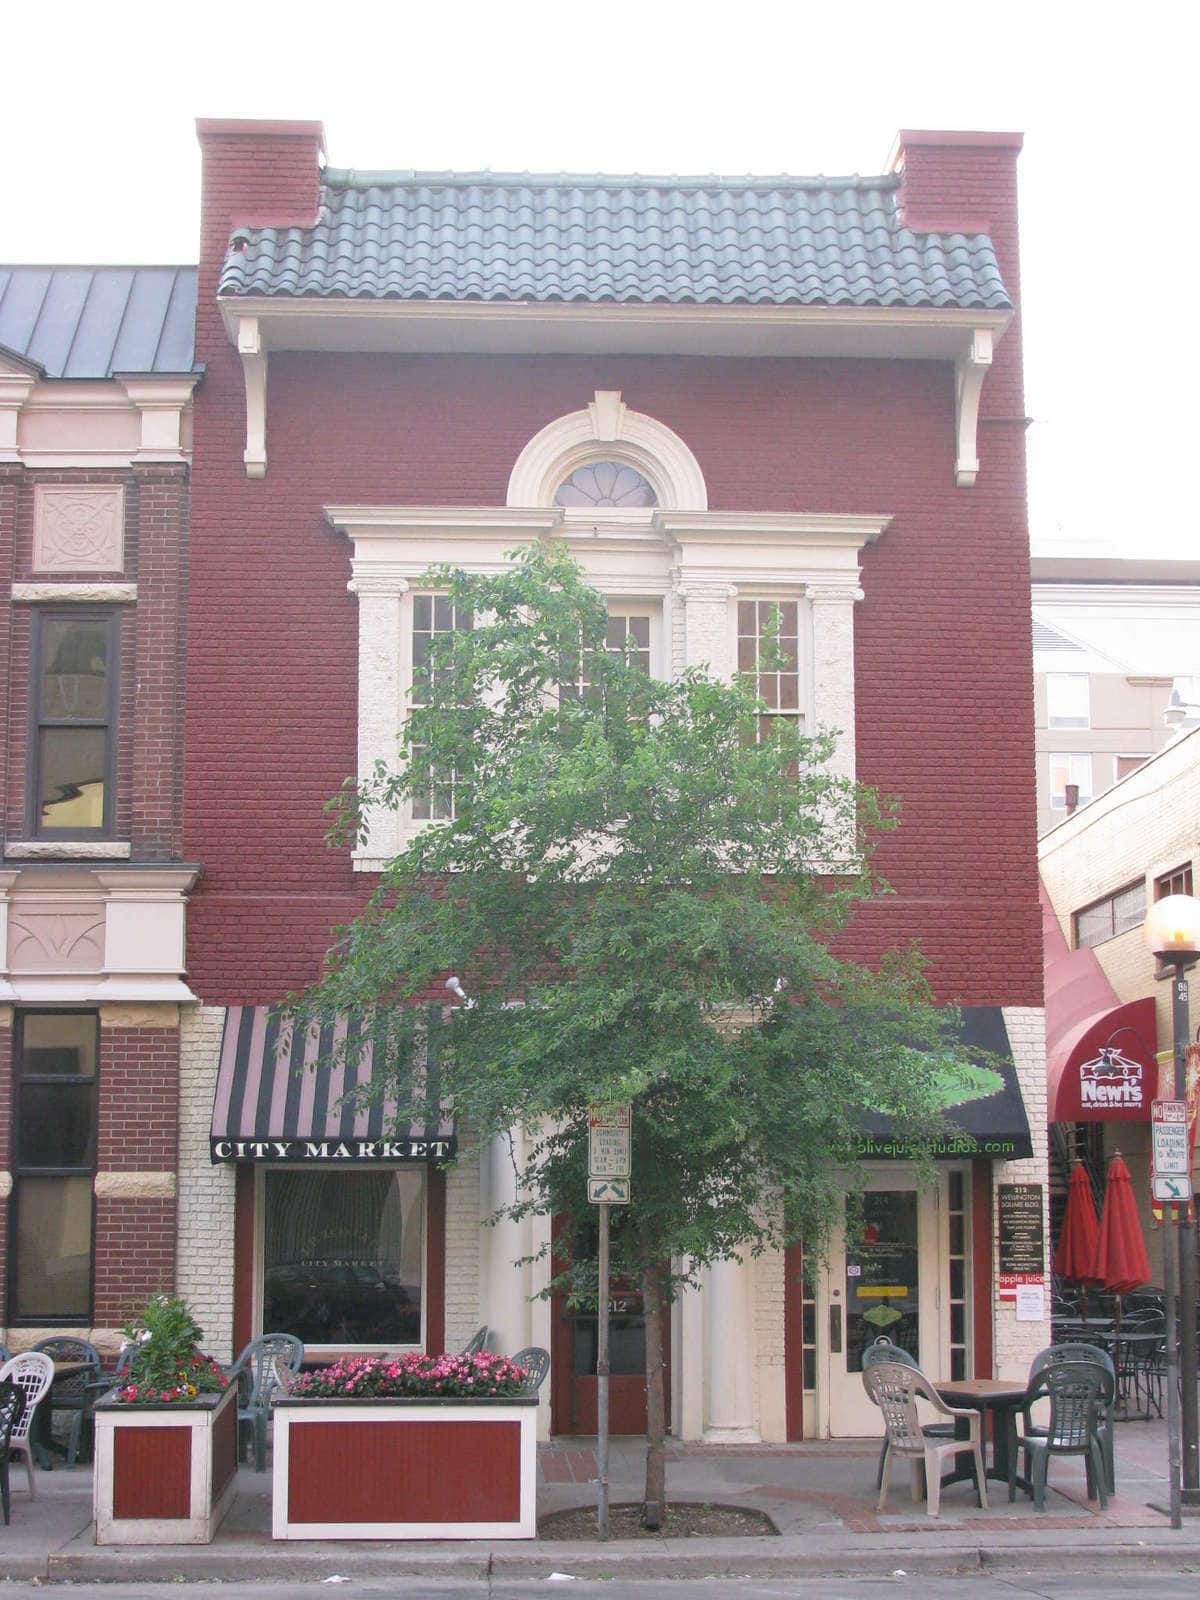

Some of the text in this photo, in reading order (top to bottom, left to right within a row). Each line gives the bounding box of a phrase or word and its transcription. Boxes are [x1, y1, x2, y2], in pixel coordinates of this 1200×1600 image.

[1081, 1078, 1142, 1102] Newt's
[1153, 1104, 1163, 1119] NO
[1155, 1126, 1185, 1136] PASSENGER
[215, 1141, 450, 1158] CITY MARKET
[1157, 1138, 1185, 1148] LOADING
[1000, 1273, 1023, 1287] apple
